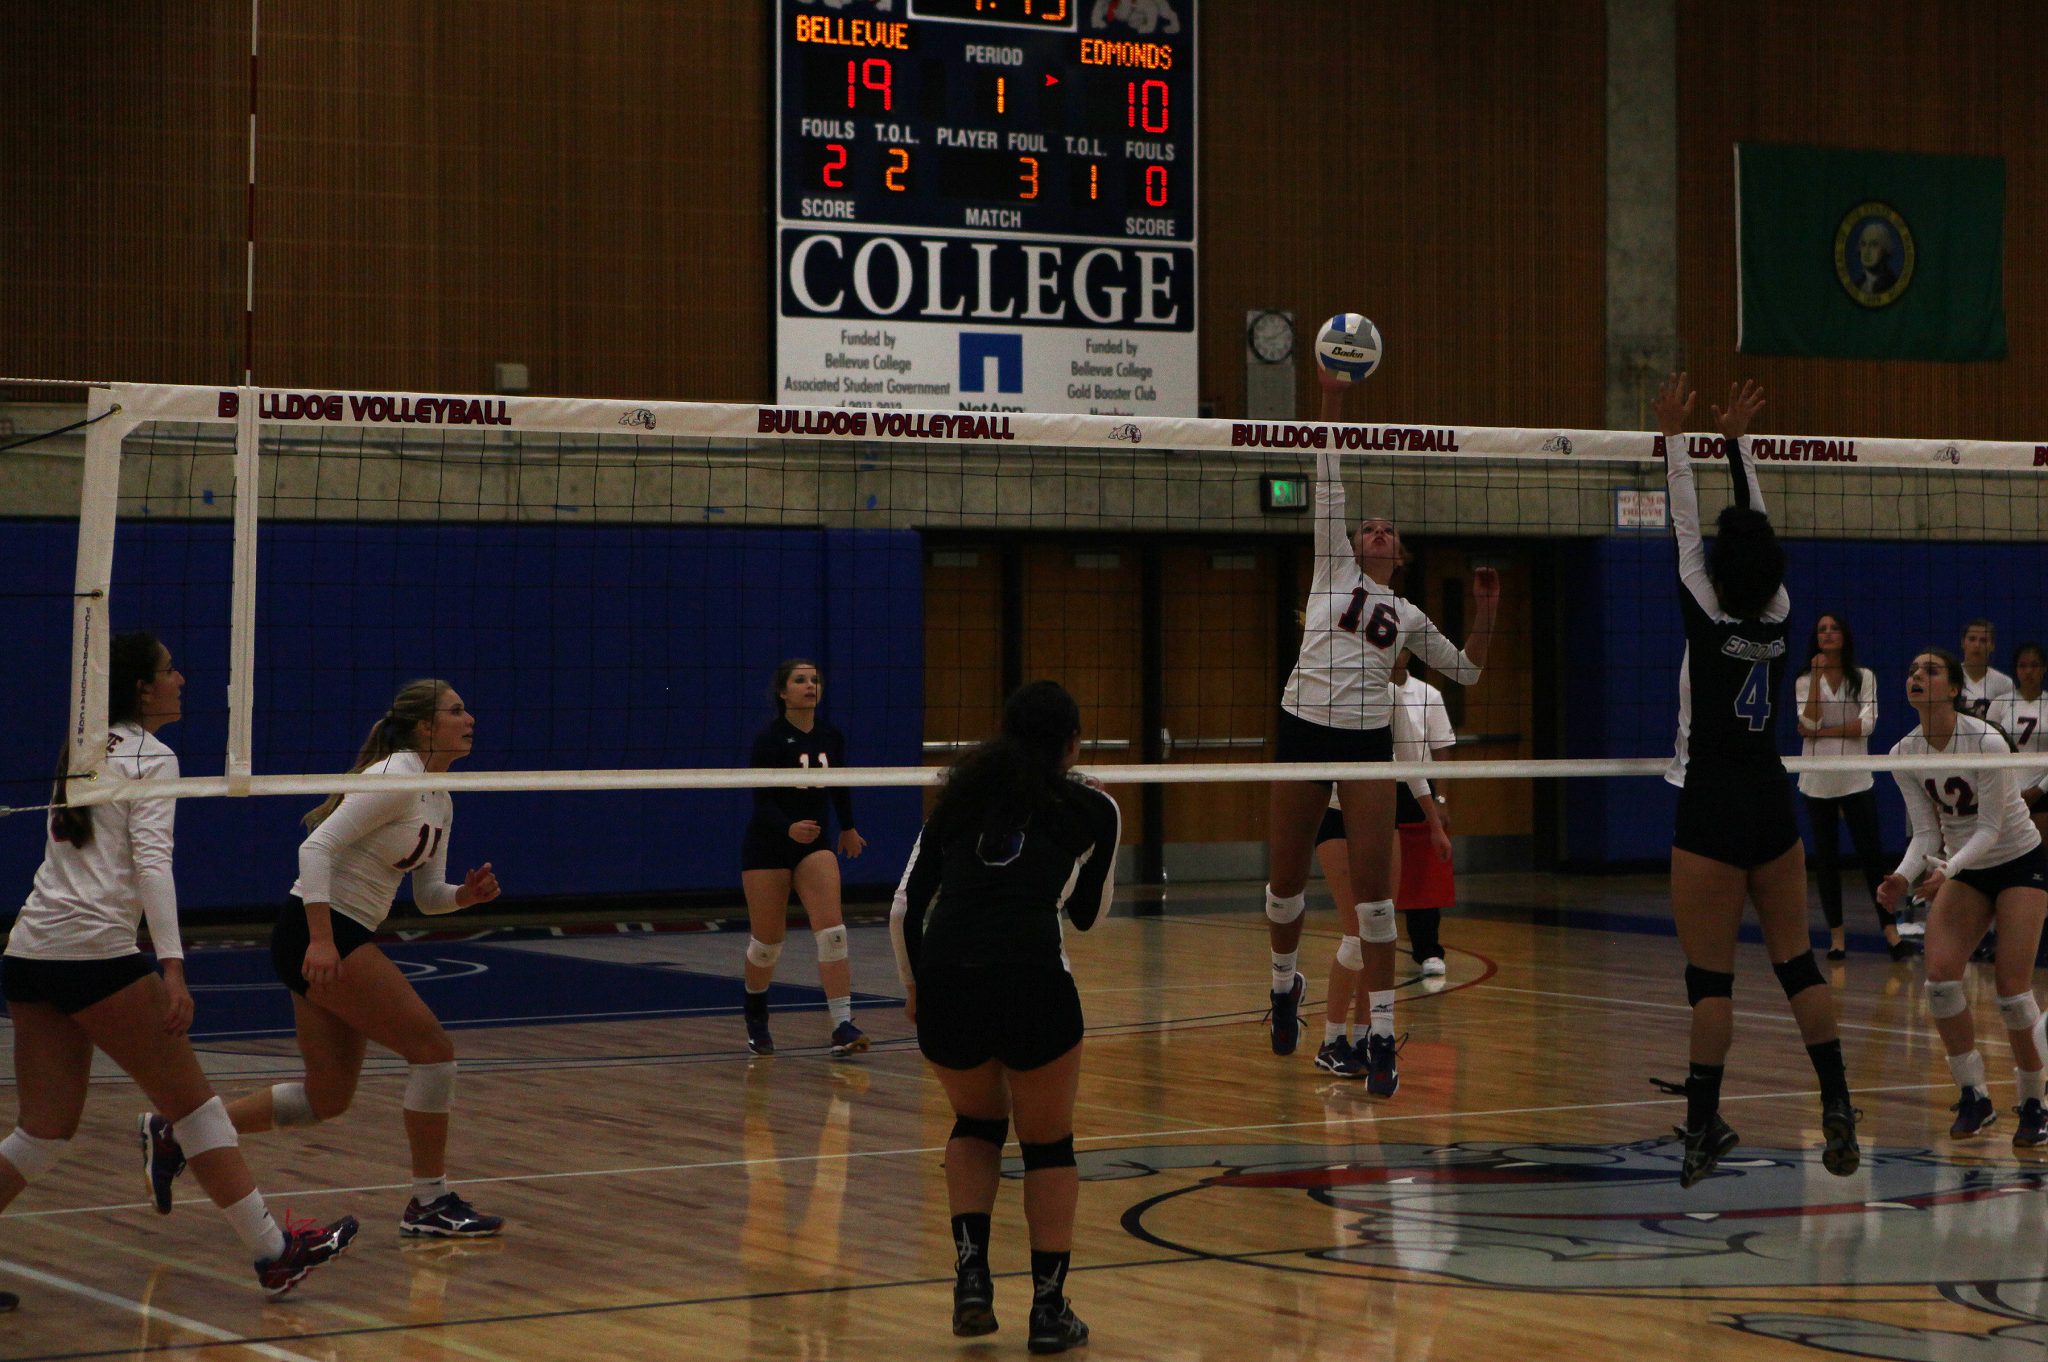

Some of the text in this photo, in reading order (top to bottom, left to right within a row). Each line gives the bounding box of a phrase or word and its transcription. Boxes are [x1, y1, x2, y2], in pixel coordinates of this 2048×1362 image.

[796, 13, 909, 50] BELLEVUE
[965, 44, 1023, 66] PERIOD
[1080, 37, 1173, 70] EDMONDS
[847, 57, 892, 111] 19
[996, 76, 1005, 115] 1
[1127, 79, 1169, 134] 10
[801, 118, 855, 140] FOULS
[875, 123, 920, 144] T.O.L.
[937, 127, 1048, 153] PLAYER FOUL
[1065, 136, 1107, 156] T.O.L.
[1125, 141, 1175, 161] FOULS
[823, 144, 848, 188] 2
[885, 147, 909, 192] 2
[1018, 156, 1039, 200] 3
[1090, 163, 1098, 200] 1
[1145, 165, 1168, 207] 0
[801, 198, 855, 219] SCORE
[965, 208, 1021, 228] MATCH
[1125, 217, 1175, 236] SCORE
[789, 234, 1179, 324] COLLEGE
[841, 330, 895, 349] Funded by
[1086, 338, 1137, 356] Funded by
[825, 353, 911, 374] Bellevue College
[1071, 361, 1152, 380] Bellevue College
[785, 376, 950, 395] Associated Student Government
[1067, 384, 1156, 401] Gold Booster Club
[218, 391, 511, 425] BLLDOG VOLLEYBALL
[757, 408, 1014, 440] BULLDOG VOLLEYBALL
[1232, 424, 1458, 451] BULLDOG VOLLEYBALL
[1652, 436, 1729, 459] BLDO
[1338, 586, 1400, 649] 16
[1733, 658, 1771, 731] 4
[2017, 716, 2038, 745] 7
[1925, 776, 1978, 816] 12
